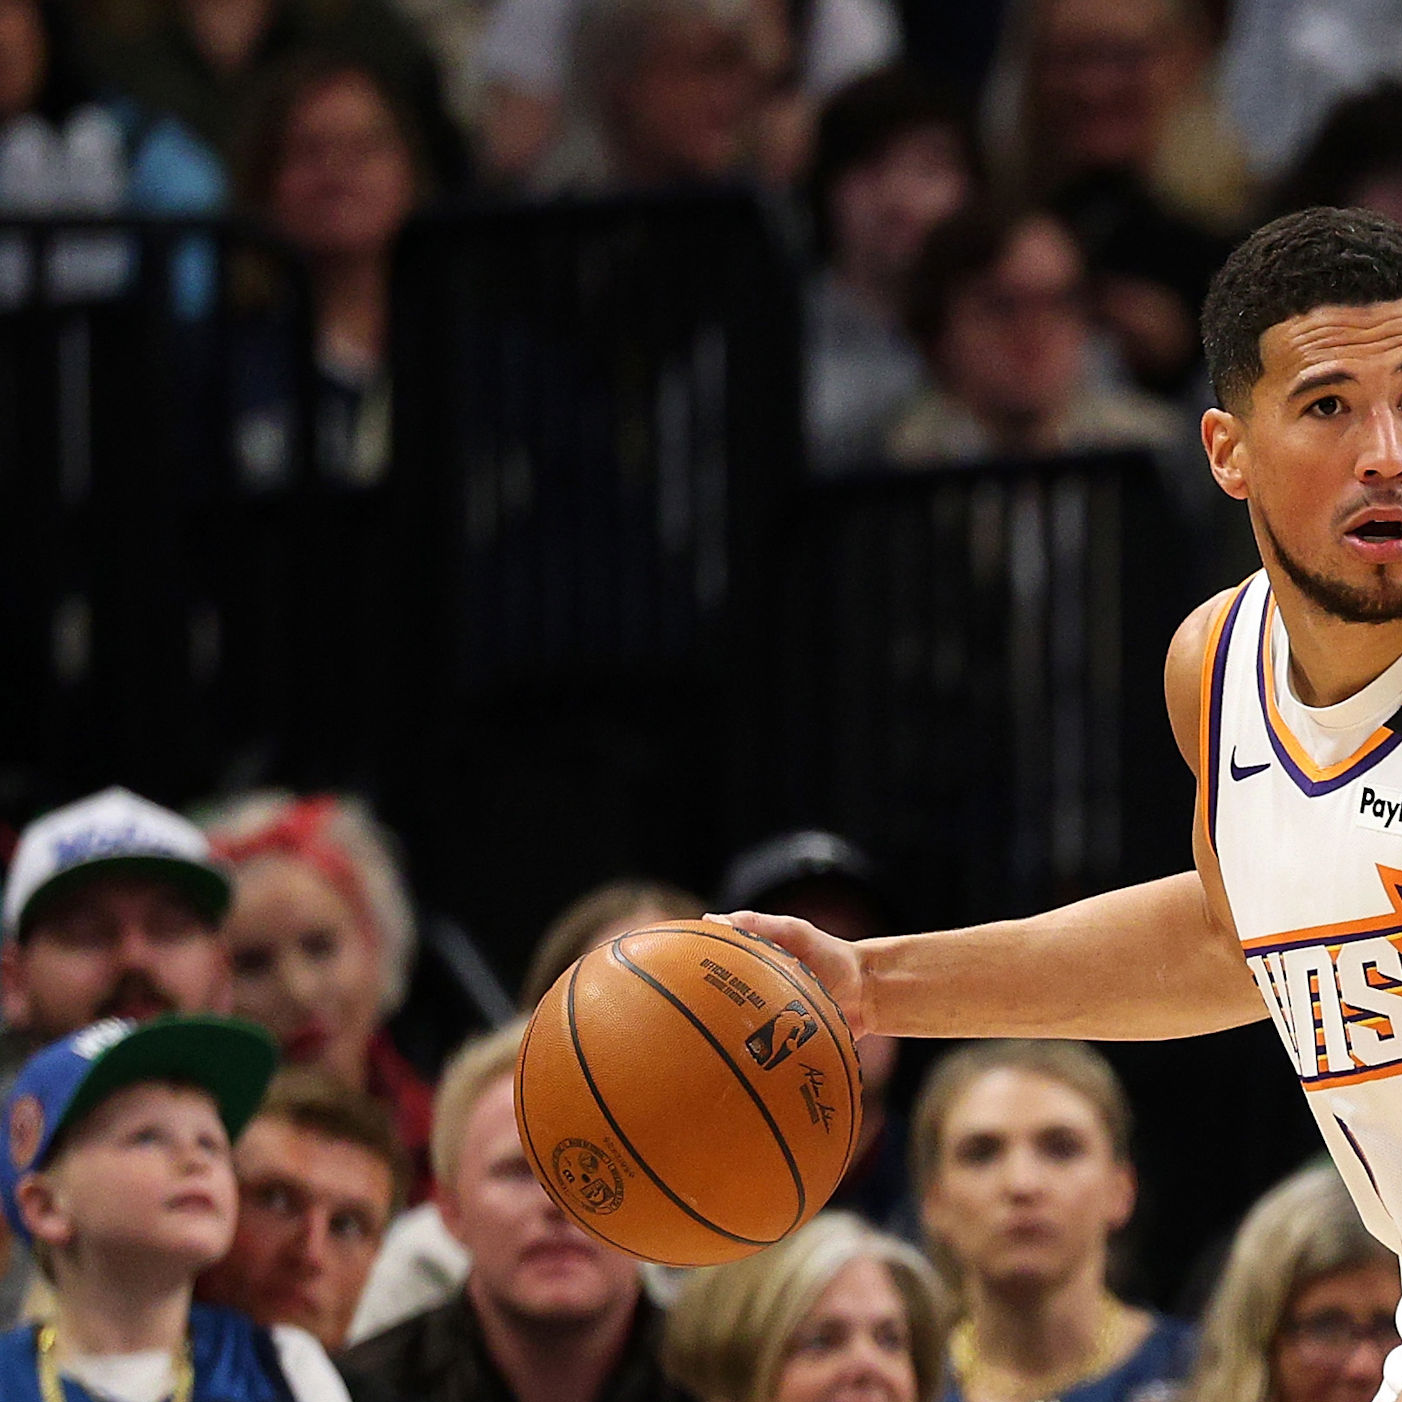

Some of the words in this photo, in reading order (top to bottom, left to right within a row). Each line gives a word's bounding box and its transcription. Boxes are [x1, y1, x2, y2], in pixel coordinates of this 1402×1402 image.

[700, 958, 733, 982] OFFICIAL
[729, 977, 752, 998] GAME
[748, 991, 767, 1010] BALL
